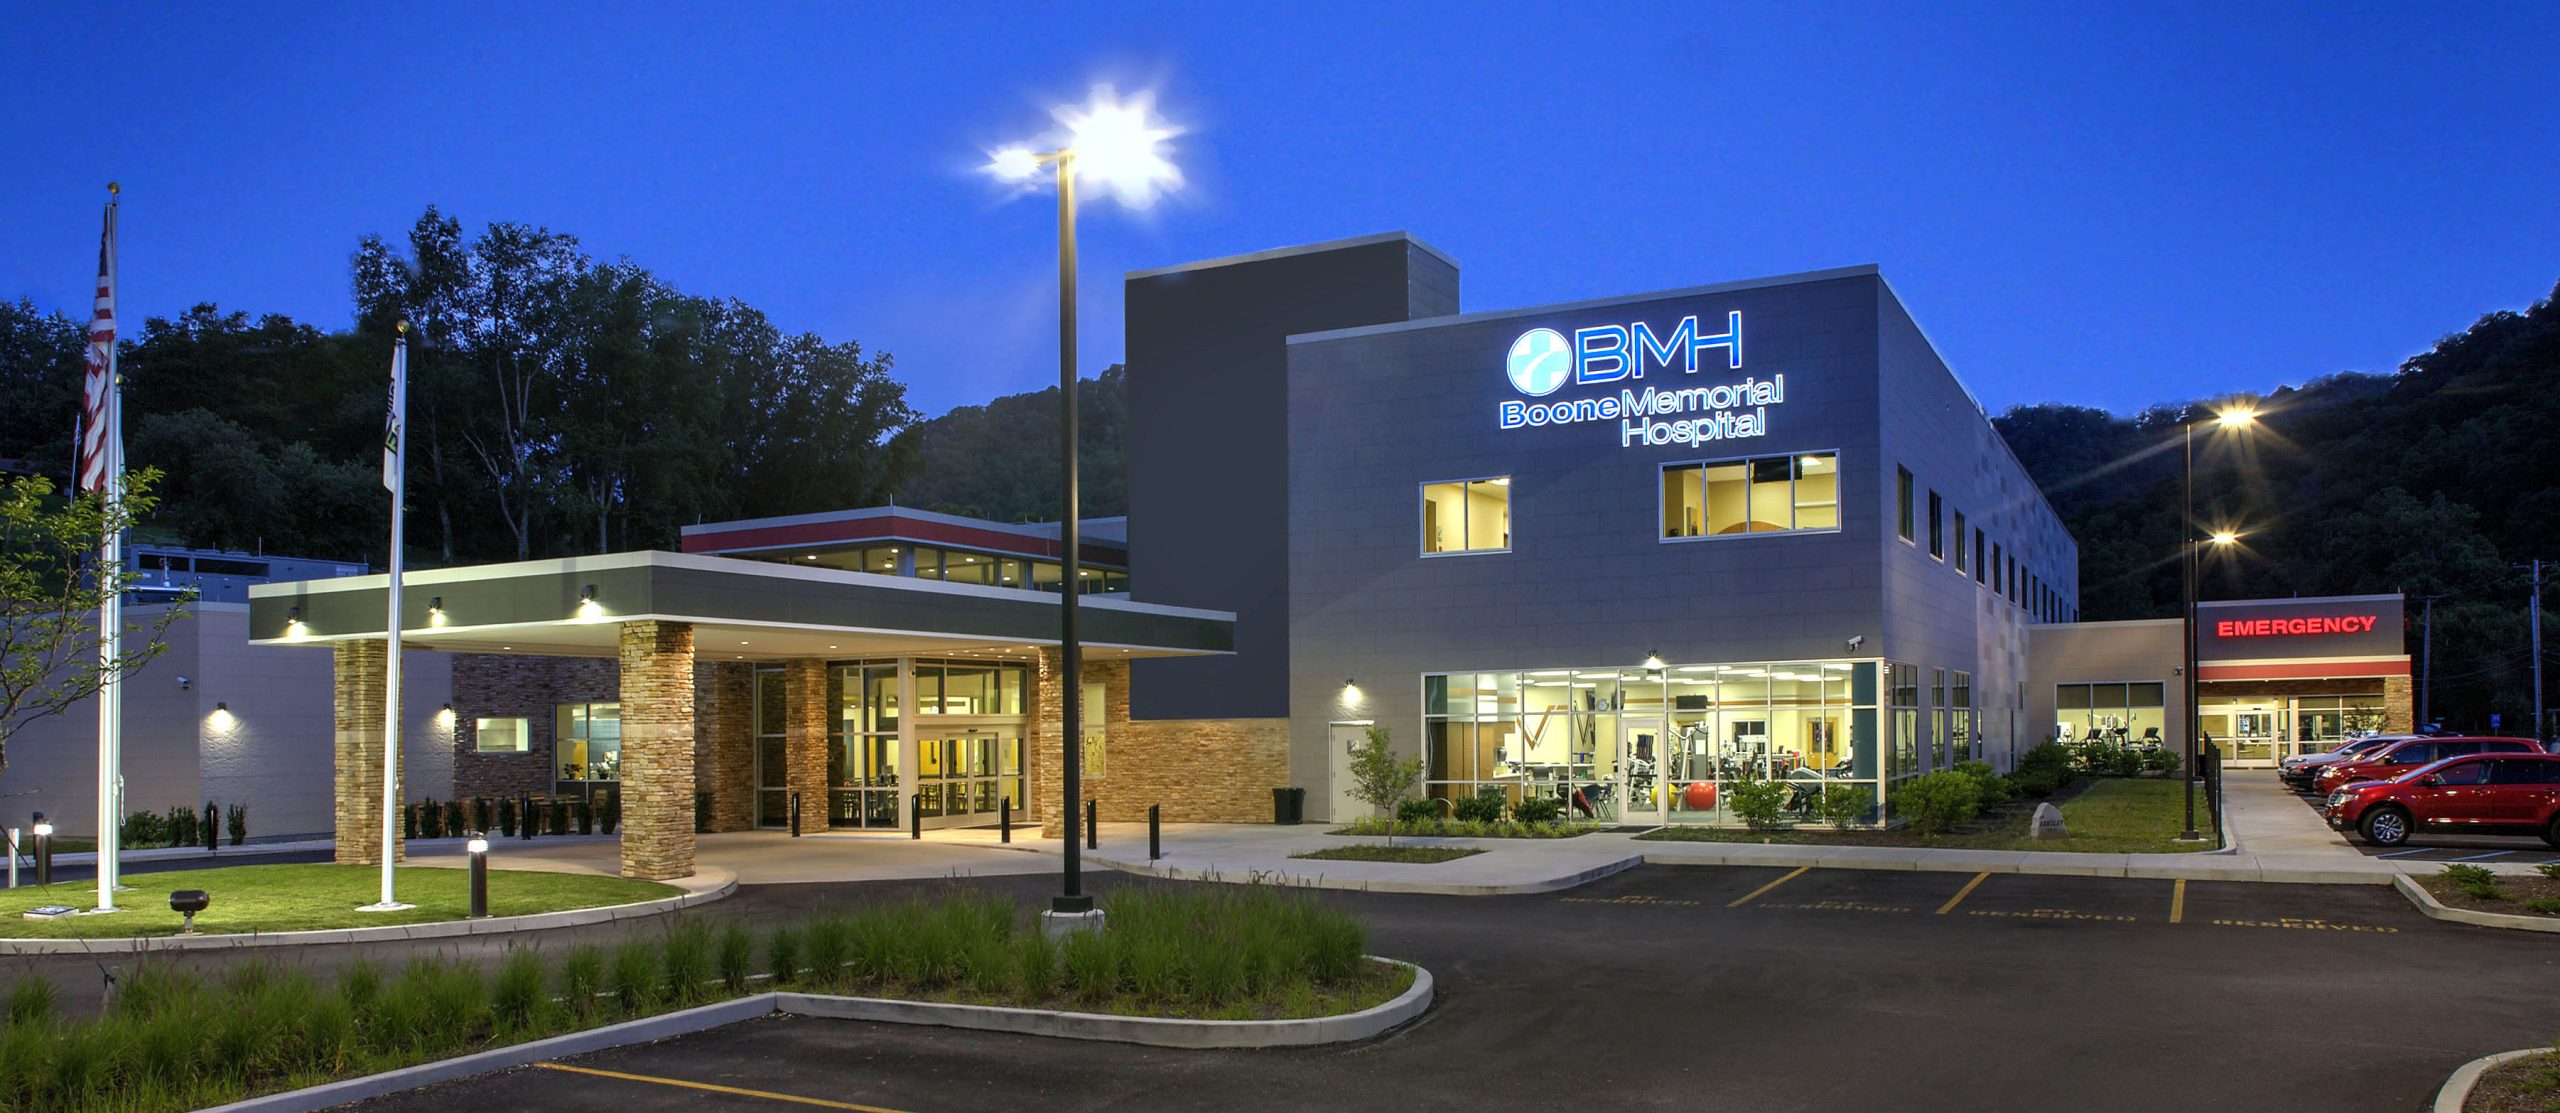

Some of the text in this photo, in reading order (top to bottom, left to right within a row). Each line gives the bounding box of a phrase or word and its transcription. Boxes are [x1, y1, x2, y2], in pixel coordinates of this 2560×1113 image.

[1575, 311, 1741, 385] BMH
[1500, 374, 1783, 429] Boone Memorial
[1622, 407, 1765, 447] Hospital
[2218, 616, 2376, 636] EMERGENCY
[2213, 920, 2398, 932] RESERVED
